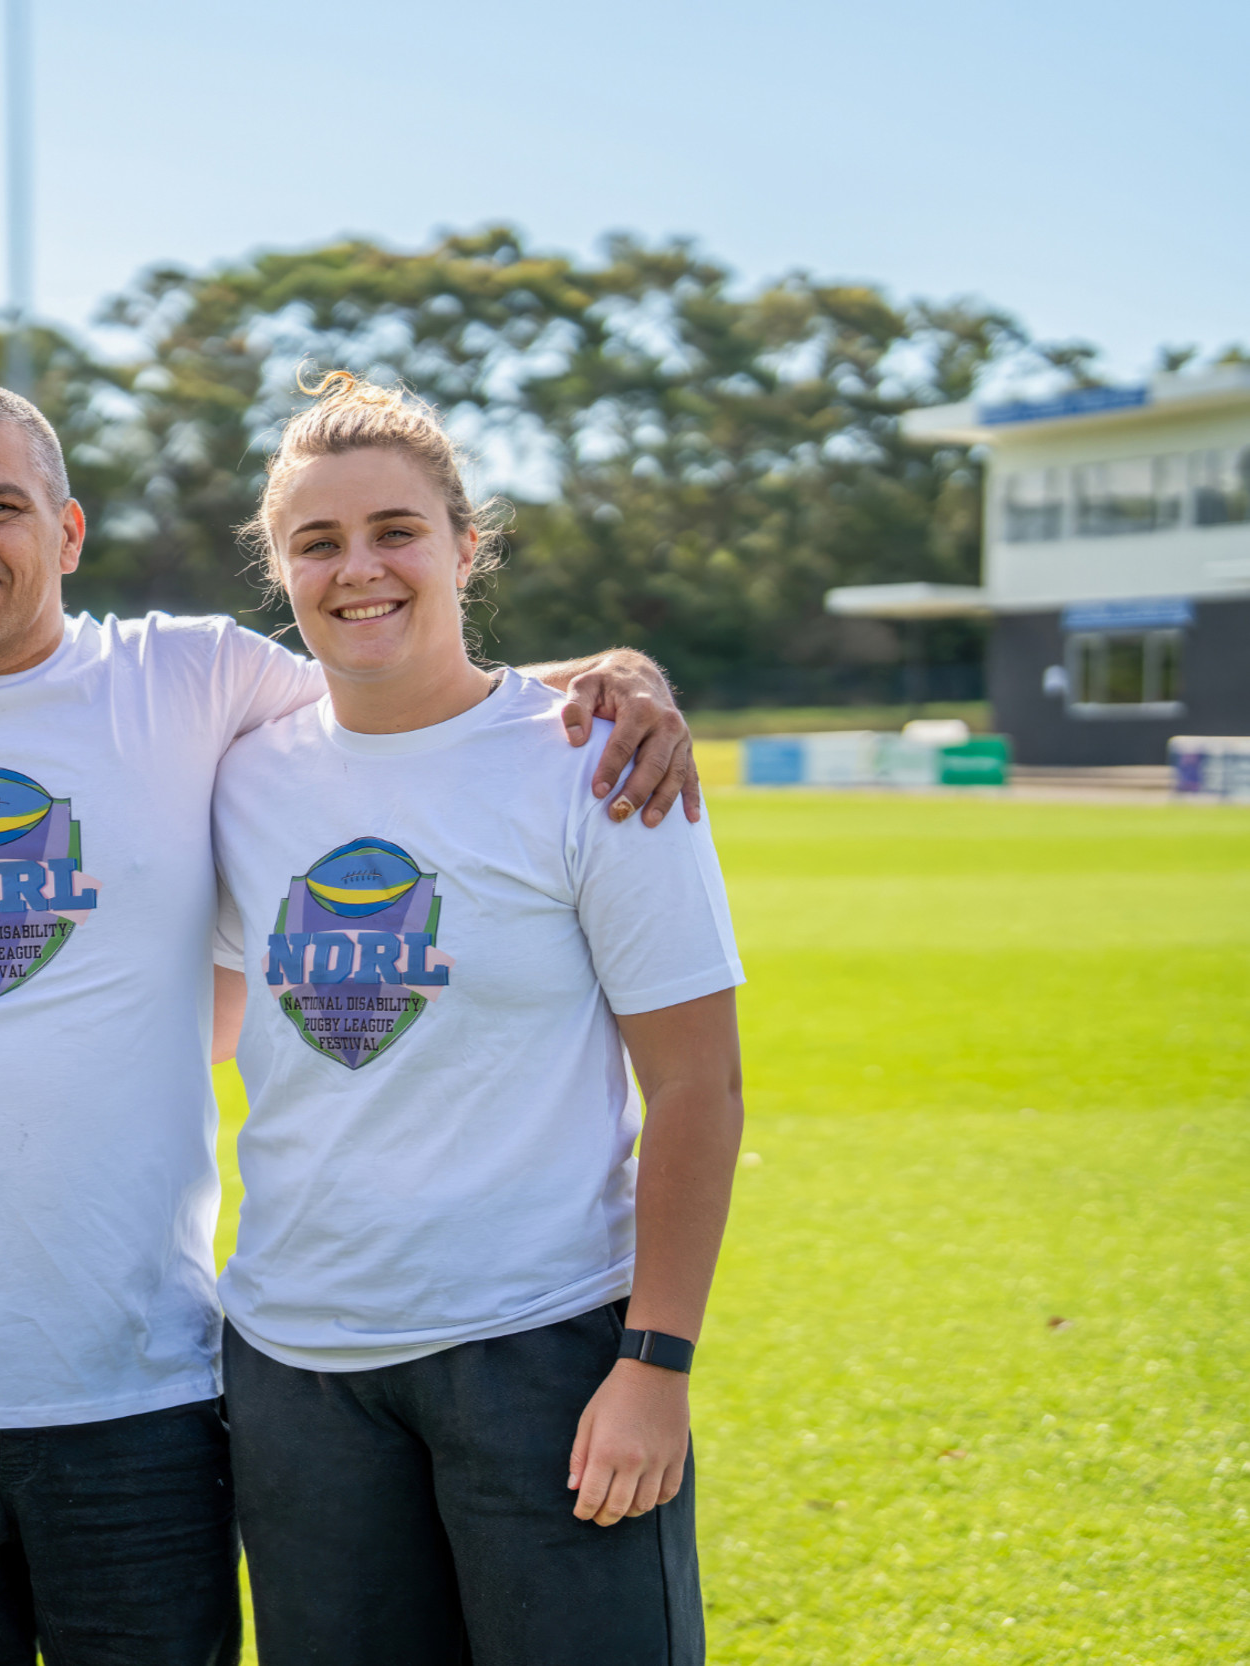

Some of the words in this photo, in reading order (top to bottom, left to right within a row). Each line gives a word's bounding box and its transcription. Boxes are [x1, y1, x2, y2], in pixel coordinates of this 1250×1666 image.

[265, 932, 449, 985] NDRL
[284, 996, 343, 1011] NATIONAL
[346, 996, 421, 1012] DISABILITY
[303, 1018, 341, 1032] RUGBY
[344, 1018, 394, 1033] LEAGUE
[318, 1036, 380, 1051] FESTIVAL
